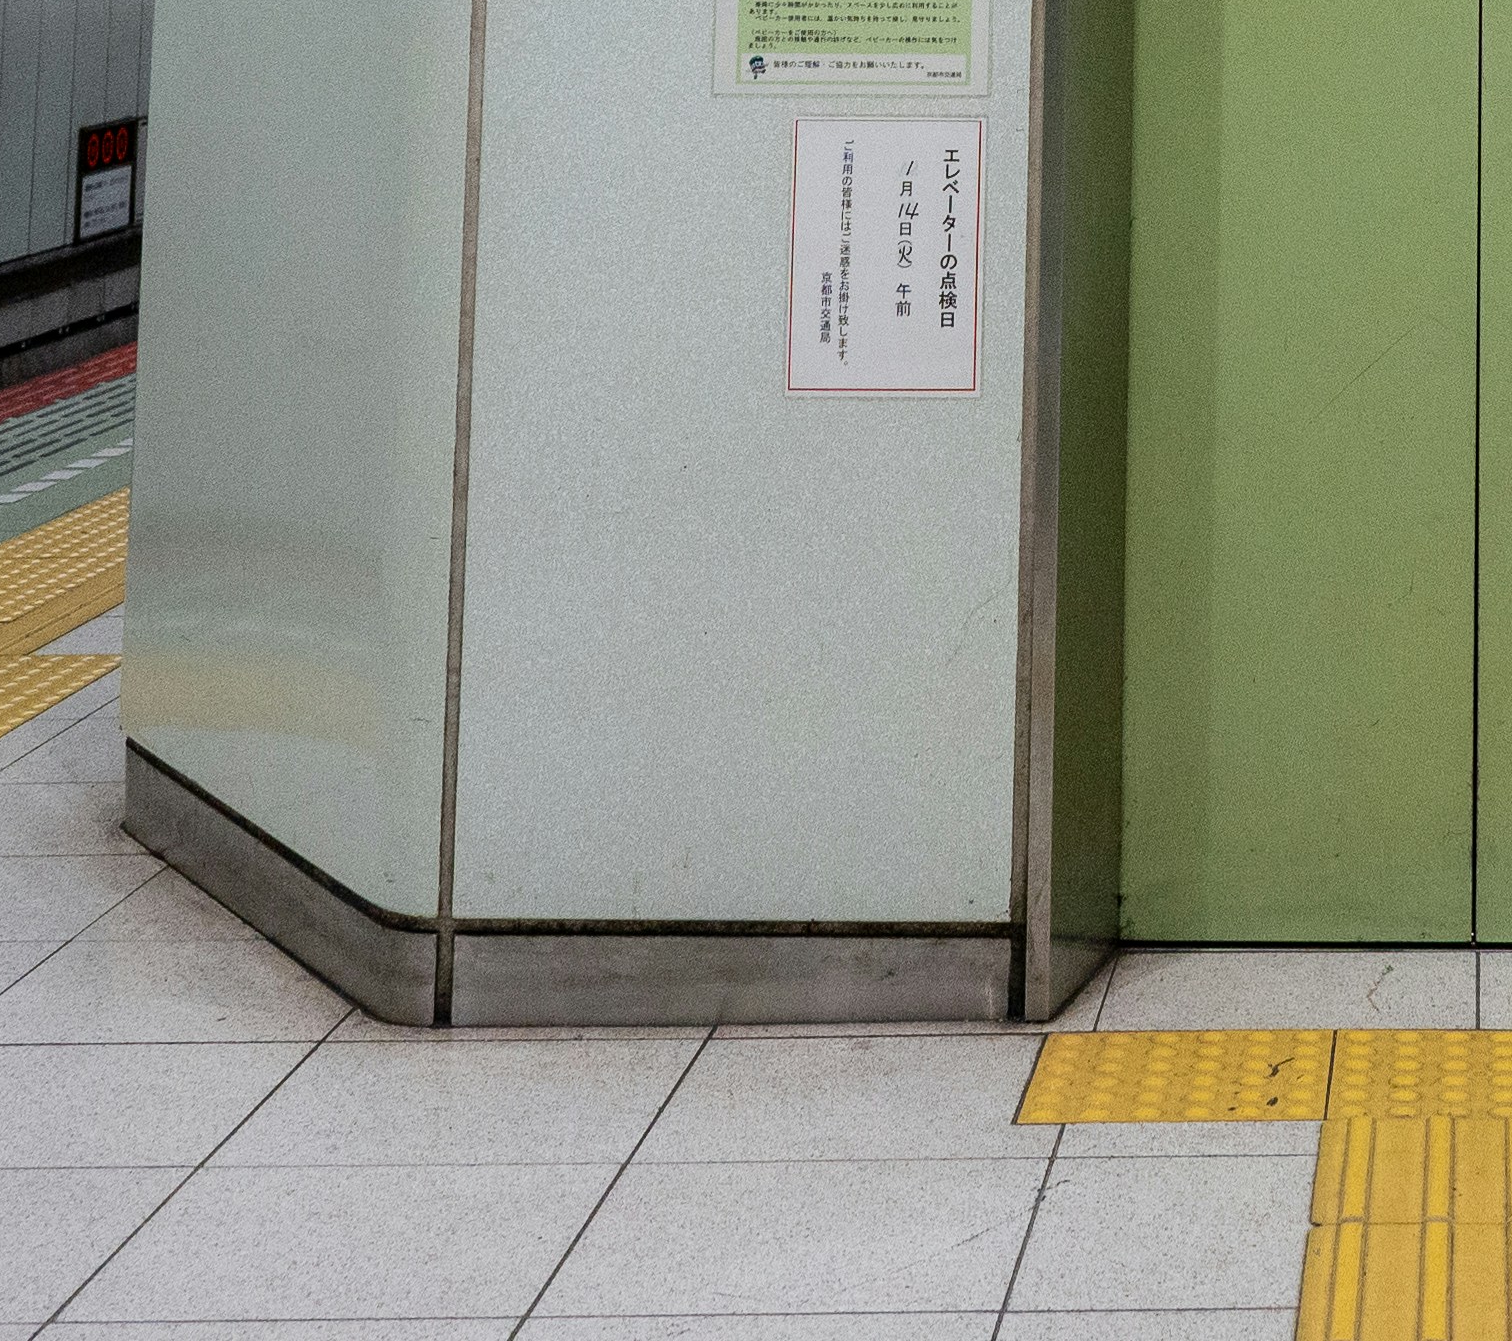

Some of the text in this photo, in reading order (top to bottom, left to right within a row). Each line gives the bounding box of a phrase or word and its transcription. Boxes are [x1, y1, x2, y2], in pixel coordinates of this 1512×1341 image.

[939, 149, 960, 329] エレベーターの点検日
[819, 271, 834, 344] 京都市交通局
[895, 282, 913, 317] 午前
